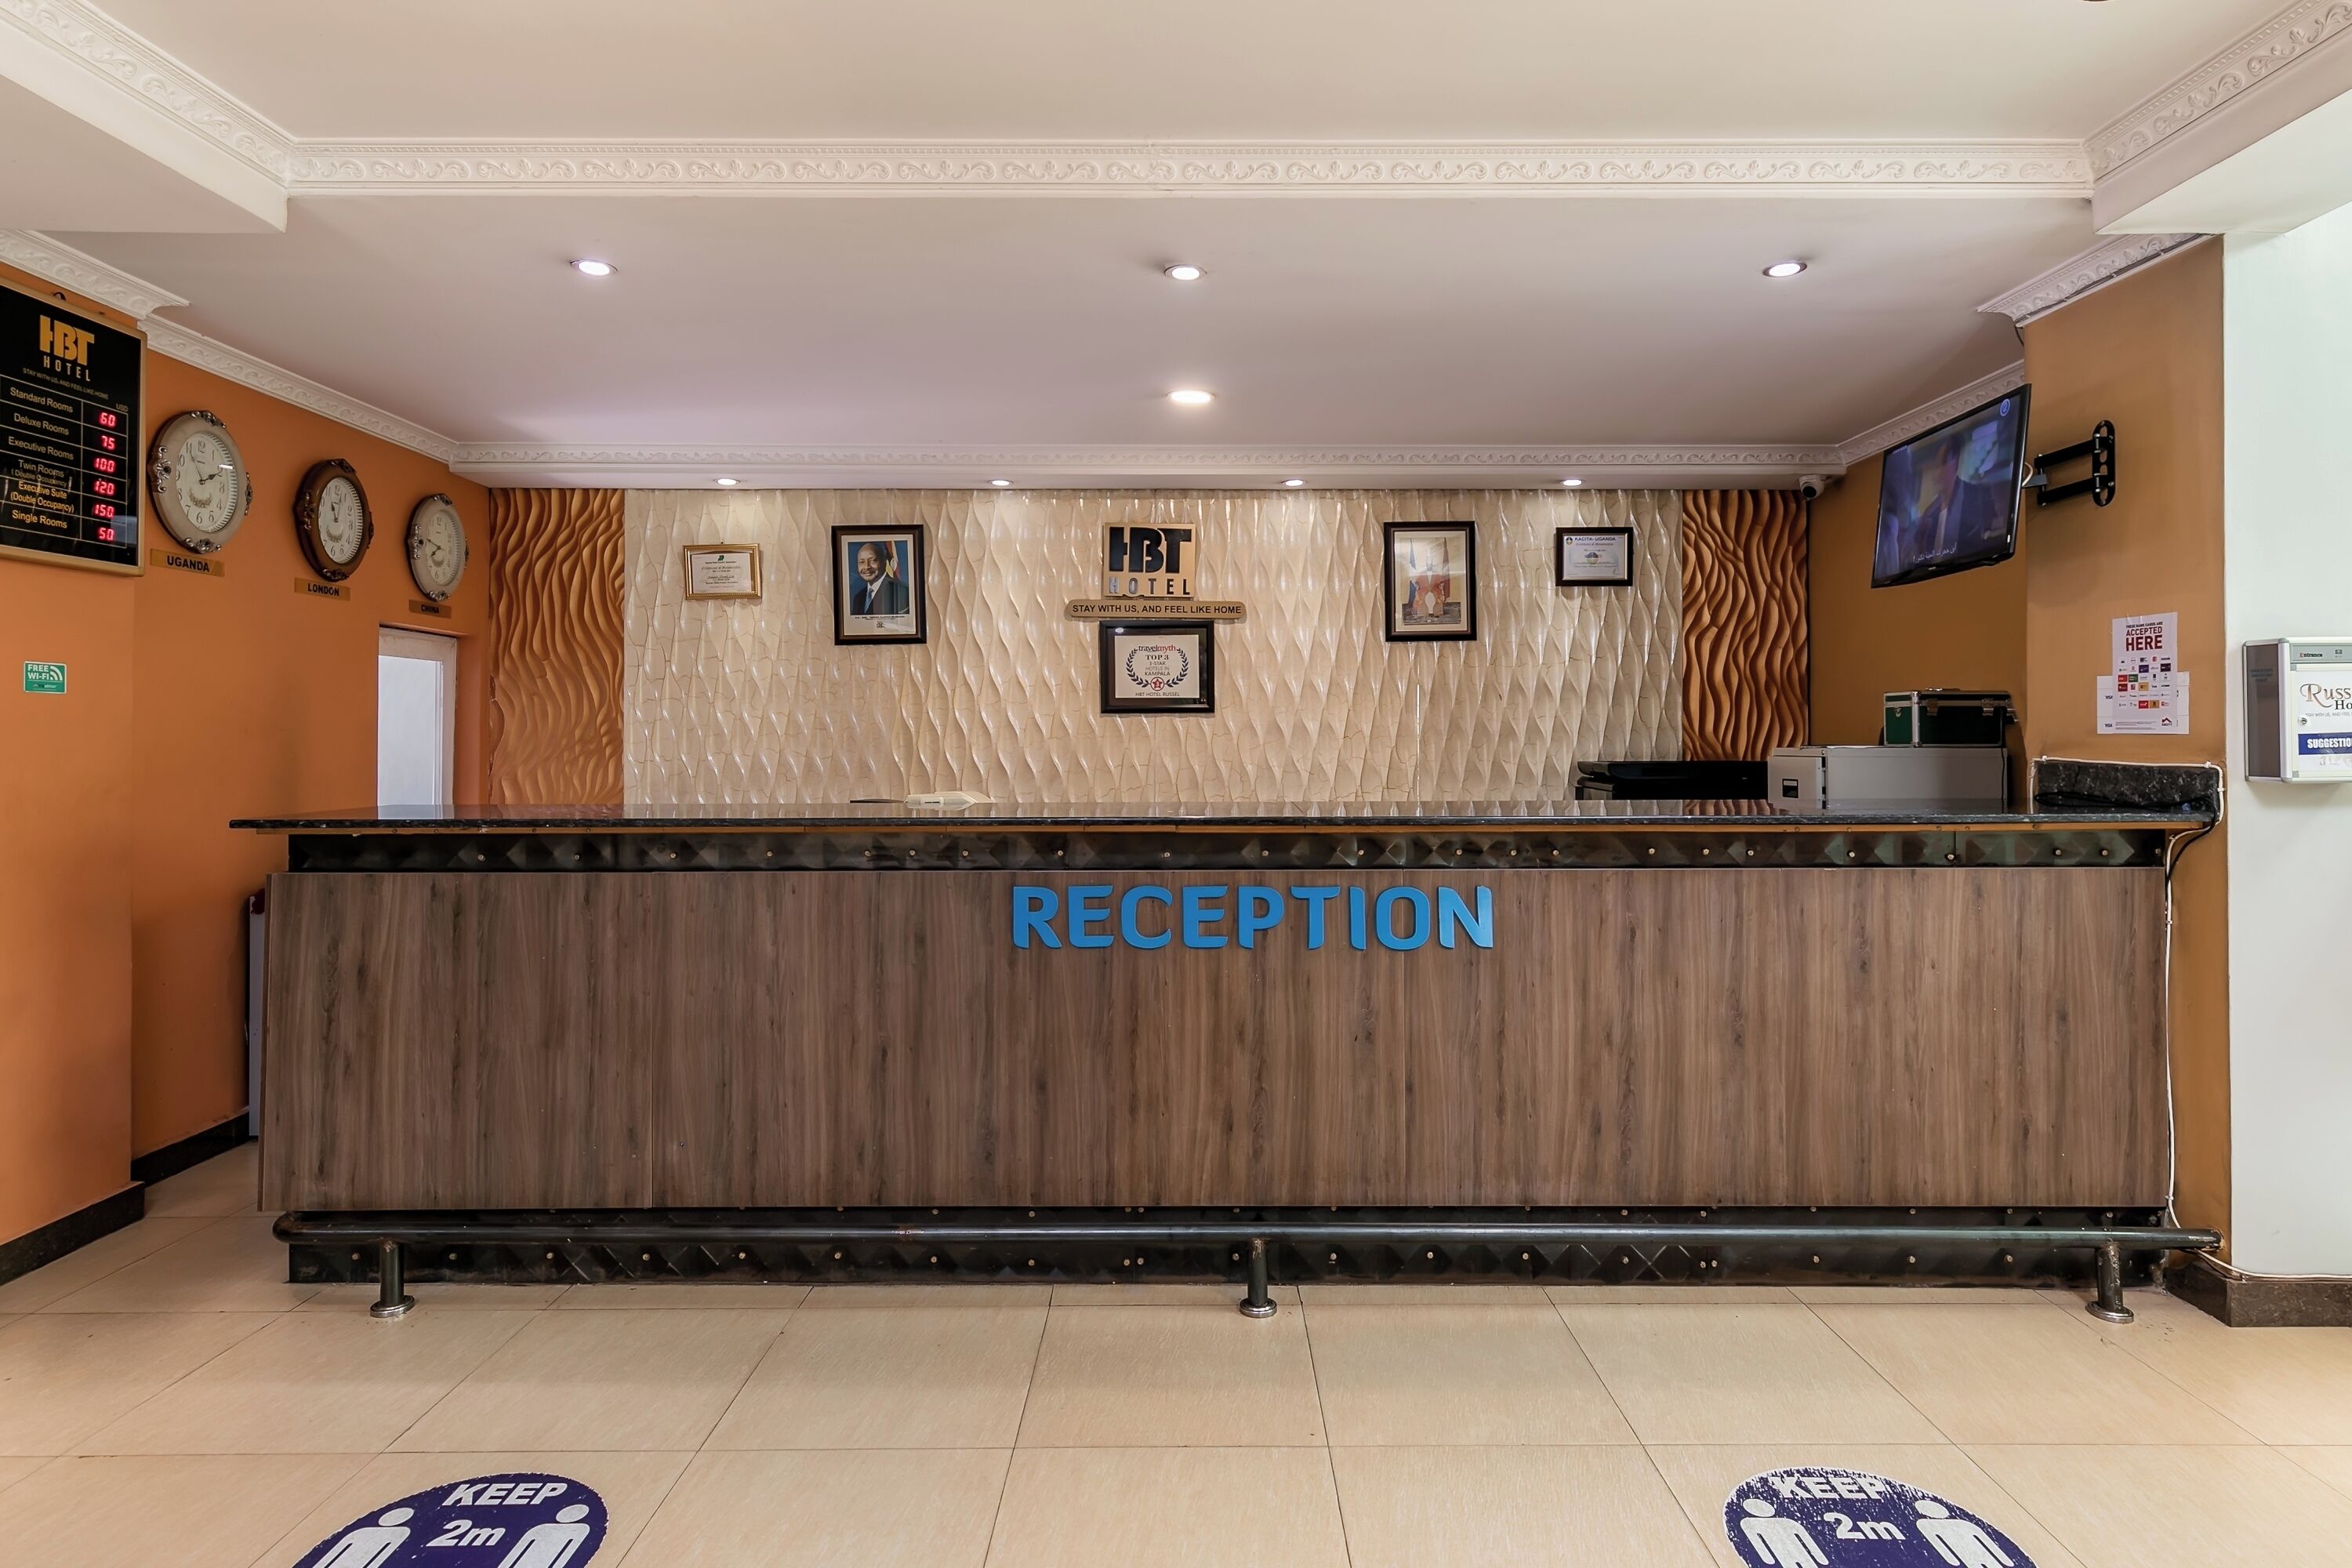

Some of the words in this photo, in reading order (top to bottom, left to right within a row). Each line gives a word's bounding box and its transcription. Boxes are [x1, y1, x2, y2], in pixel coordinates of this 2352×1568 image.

[40, 314, 95, 366] HBT
[23, 367, 36, 377] STAY
[43, 355, 91, 382] HOTEL
[10, 387, 46, 405] Standard
[47, 397, 74, 413] Rooms
[116, 403, 129, 412] USD
[14, 412, 42, 428] Deluxe
[42, 420, 70, 436] Rooms
[100, 412, 117, 426] 60
[9, 436, 46, 454] Executive
[47, 446, 74, 460] Rooms
[101, 435, 116, 450] 75
[198, 441, 205, 453] 12
[18, 459, 37, 471] Twin
[38, 464, 65, 477] Rooms
[95, 457, 116, 473] 100
[19, 481, 50, 495] Executive
[51, 488, 67, 499] Suite
[95, 480, 115, 495] 120
[10, 491, 37, 504] (Double
[38, 497, 74, 514] Occupancy)
[95, 504, 115, 518] 150
[12, 510, 38, 523] Single
[40, 515, 67, 528] Rooms
[196, 511, 202, 524] 6
[98, 527, 114, 542] 50
[1109, 526, 1192, 573] HBT
[167, 555, 210, 572] UGANDA
[307, 583, 339, 597] LONDON
[1109, 576, 1190, 596] HOTEL
[1098, 604, 1121, 613] WITH
[1124, 604, 1139, 614] US,
[1142, 604, 1162, 613] AND
[2126, 626, 2162, 637] ACCEPTED
[1138, 644, 1176, 654] travelmyth
[2126, 634, 2162, 652] HERE
[2307, 738, 2352, 749] SUGGESTIO
[1013, 884, 1494, 951] RECEPTION
[441, 1483, 568, 1506] KEEP
[1770, 1476, 1884, 1499] KEEP
[426, 1519, 506, 1547] 2m
[1823, 1512, 1907, 1541] 2m
